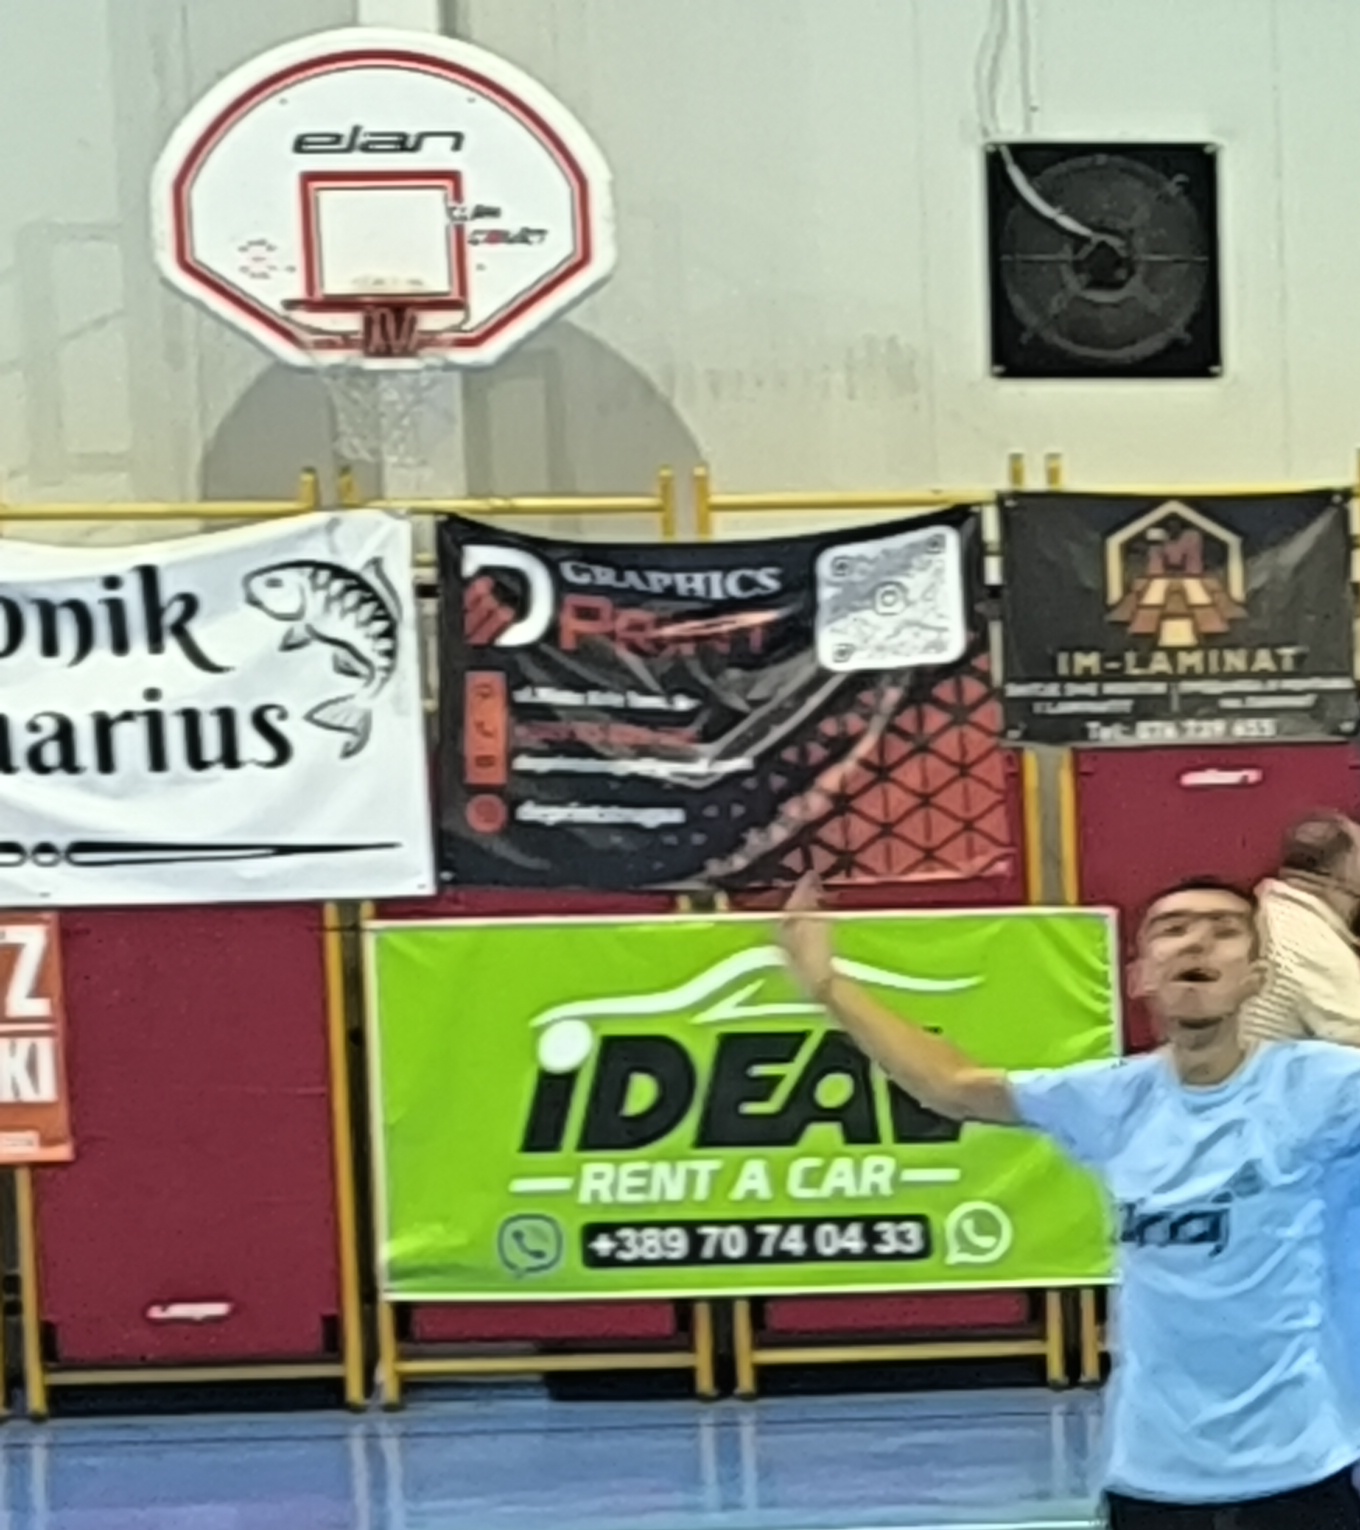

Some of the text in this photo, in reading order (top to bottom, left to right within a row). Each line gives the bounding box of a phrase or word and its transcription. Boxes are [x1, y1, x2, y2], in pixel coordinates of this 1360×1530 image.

[292, 125, 464, 154] elan
[559, 560, 783, 600] GRAPHICS
[1057, 646, 1309, 676] IM-LAMINAT
[577, 1155, 898, 1204] RENT A CAR
[588, 1220, 925, 1262] +389 70 74 04 33
